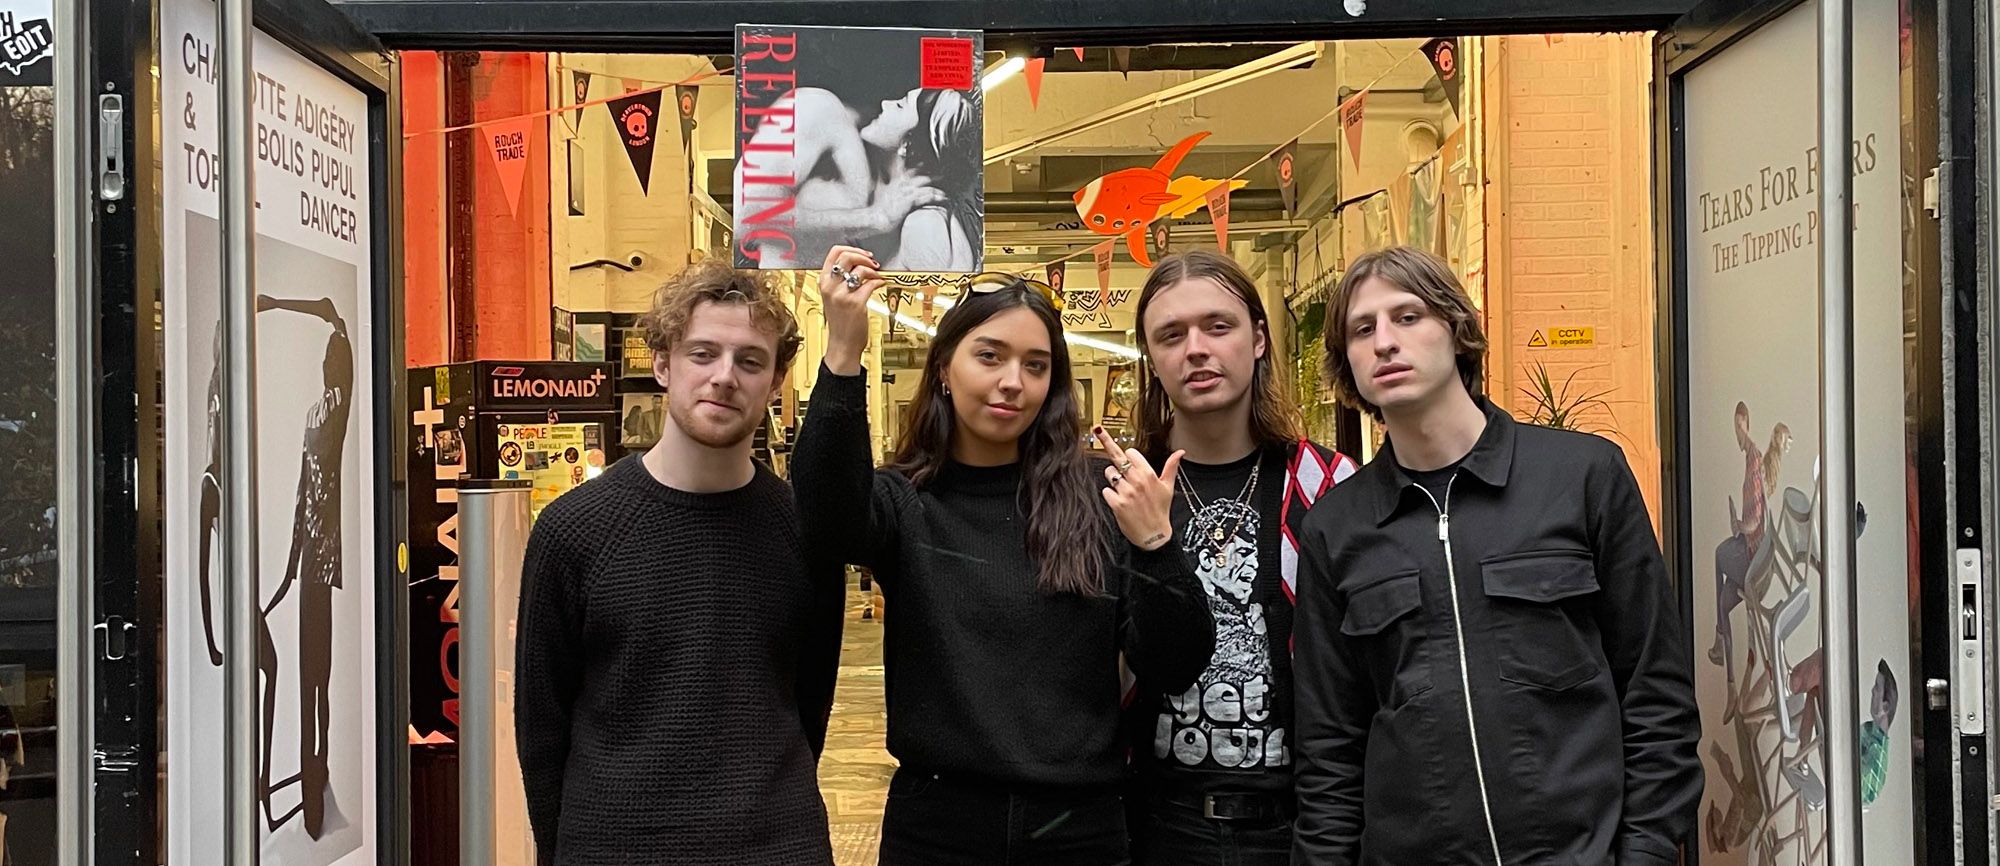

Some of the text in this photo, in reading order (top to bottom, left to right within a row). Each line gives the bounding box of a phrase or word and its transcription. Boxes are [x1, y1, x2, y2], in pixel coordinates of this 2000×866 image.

[184, 91, 196, 131] &
[258, 123, 304, 177] BOLIS
[312, 149, 356, 200] PUPUL
[295, 94, 355, 154] ADIGÉRY
[740, 32, 796, 261] REELING
[496, 145, 525, 162] TRADE
[1700, 183, 1753, 233] TEARS
[1760, 166, 1799, 211] FOR
[1805, 133, 1876, 195] FRS
[301, 190, 357, 245] DANCER
[1712, 242, 1739, 274] THE
[1742, 222, 1802, 264] TIPPING
[1558, 329, 1584, 338] CCTV
[1560, 339, 1592, 347] operation
